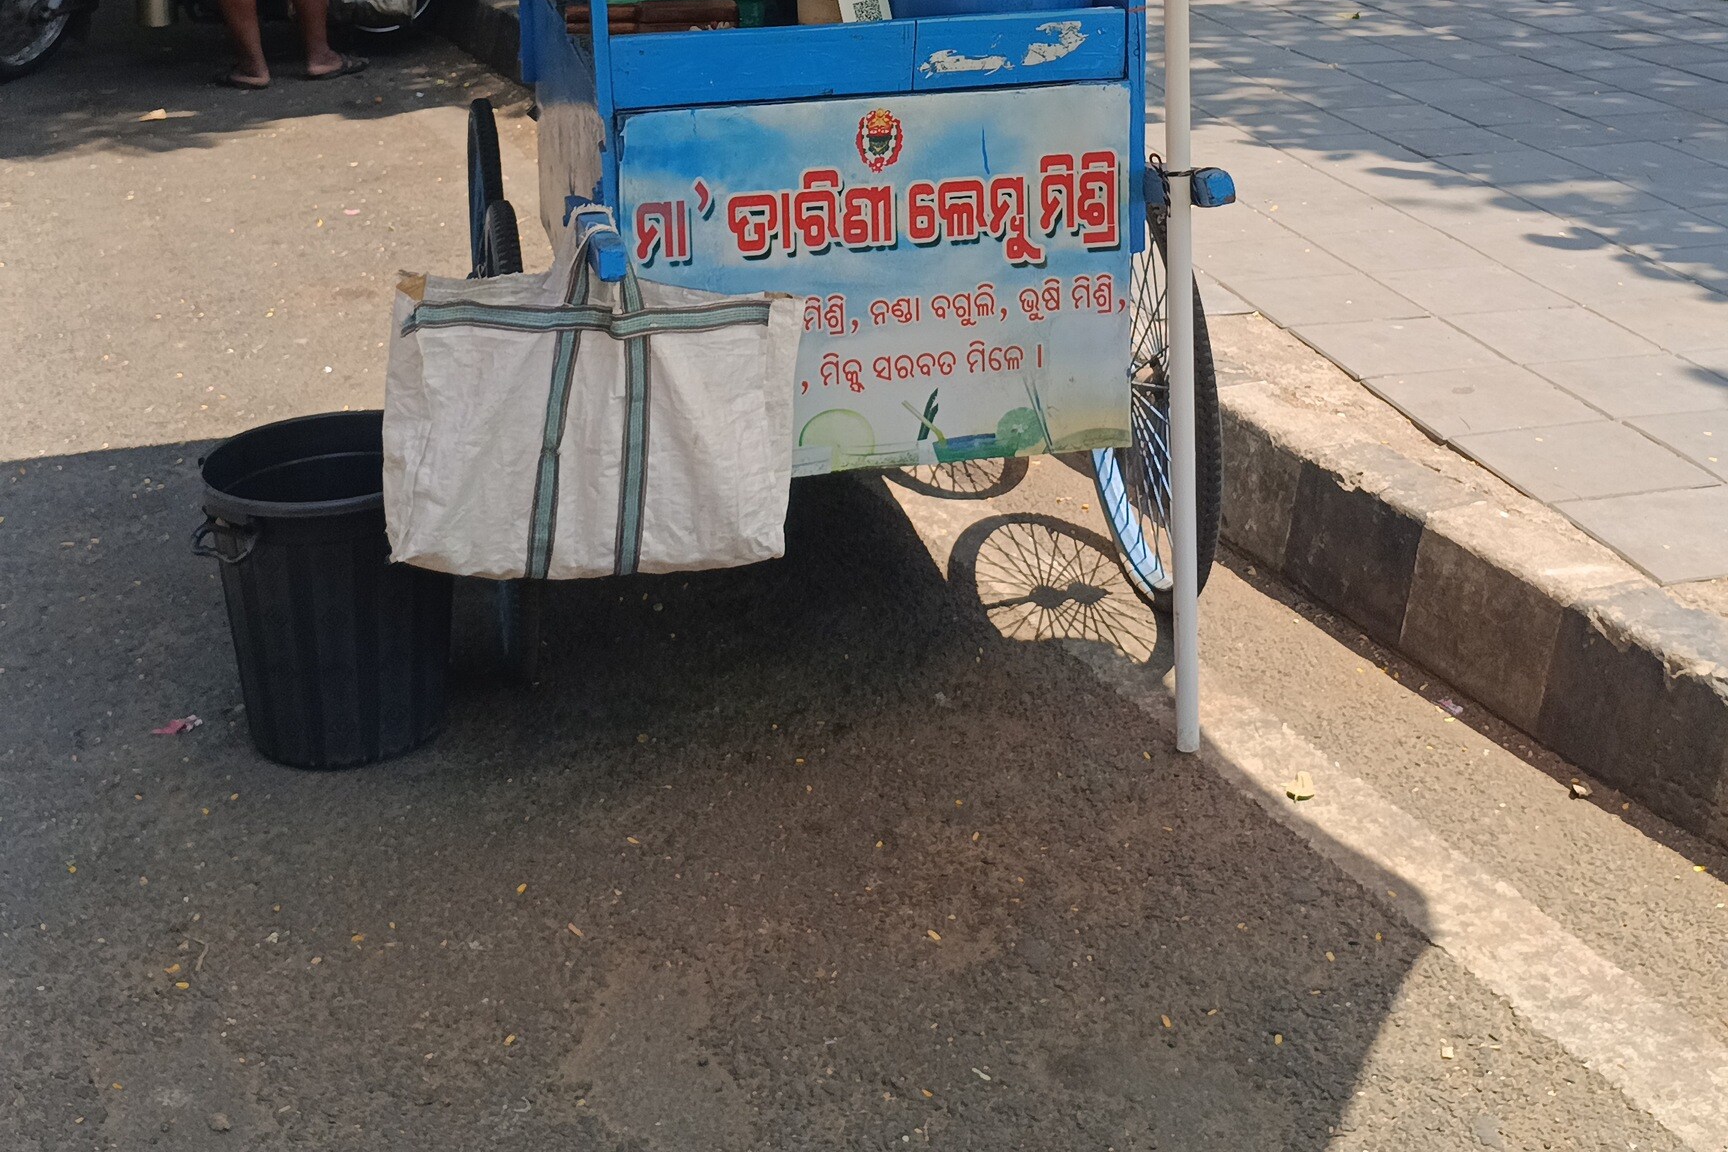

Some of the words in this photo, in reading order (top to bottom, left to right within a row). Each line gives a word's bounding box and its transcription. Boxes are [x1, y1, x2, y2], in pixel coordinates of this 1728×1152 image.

[728, 170, 892, 252] ତାରିଣୀ
[873, 351, 957, 381] ସରବତ
[966, 340, 1024, 373] ମିଳେ
